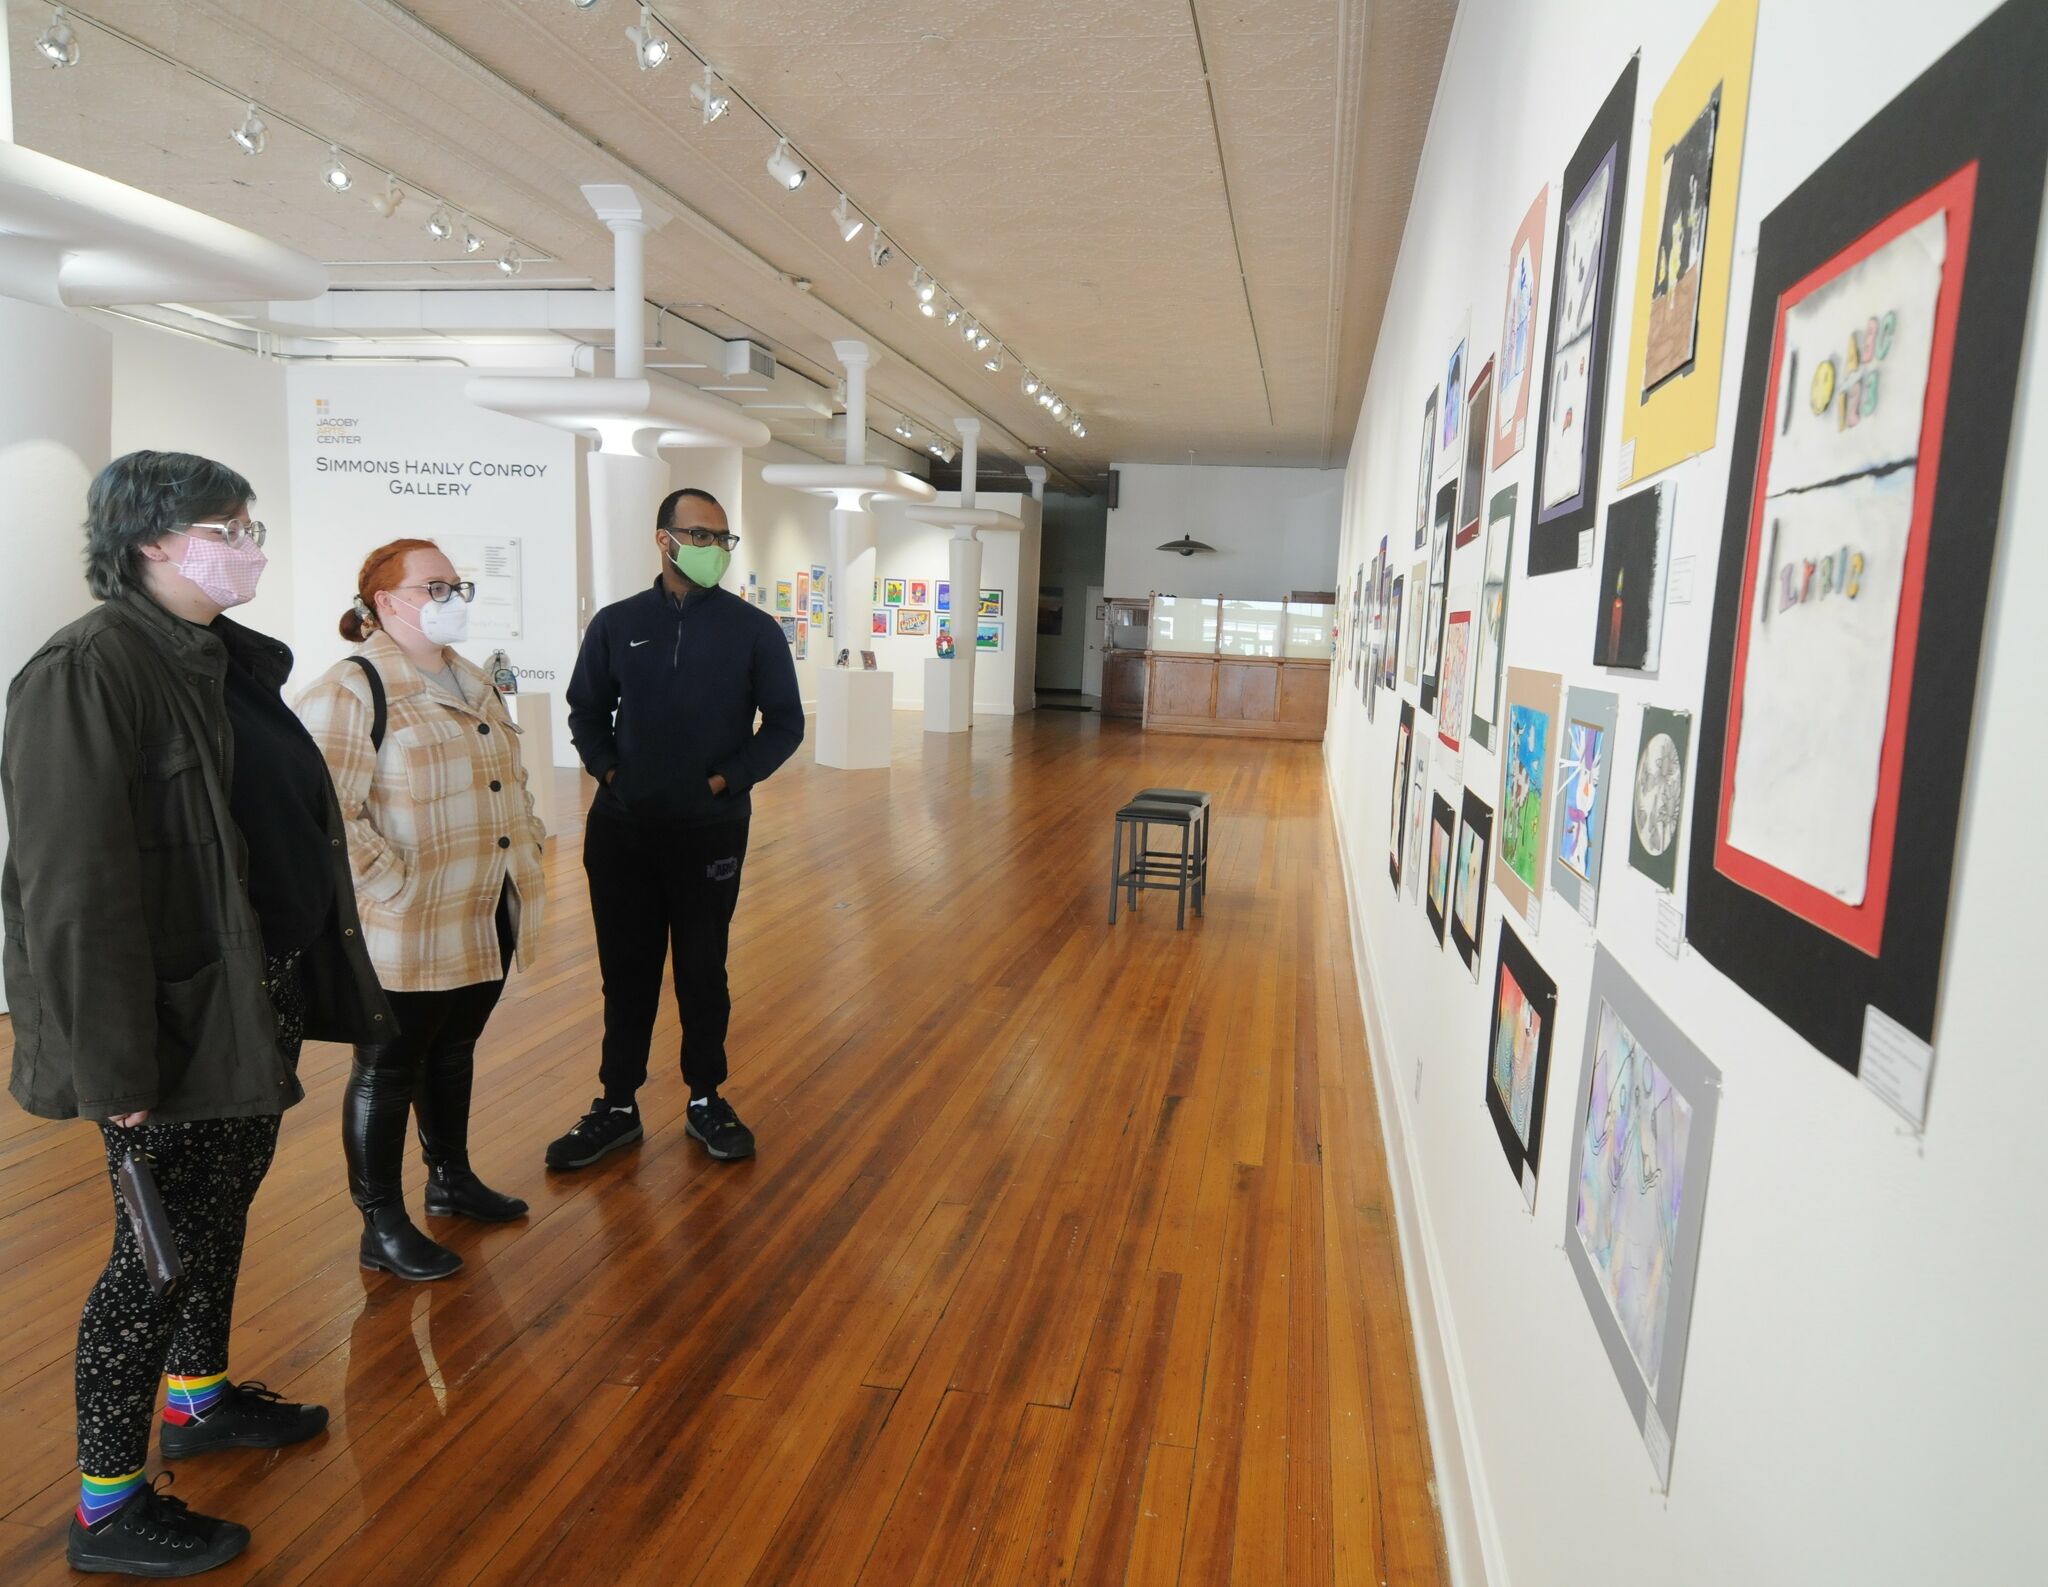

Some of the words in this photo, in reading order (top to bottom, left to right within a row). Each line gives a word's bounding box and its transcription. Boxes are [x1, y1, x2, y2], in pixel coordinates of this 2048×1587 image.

[316, 418, 360, 427] JACOBY
[316, 435, 362, 444] CENTER
[315, 457, 400, 475] SIMMONS
[405, 460, 465, 476] HANLY
[468, 461, 548, 477] CONROY
[389, 480, 472, 496] GALLERY
[511, 665, 556, 680] Donors
